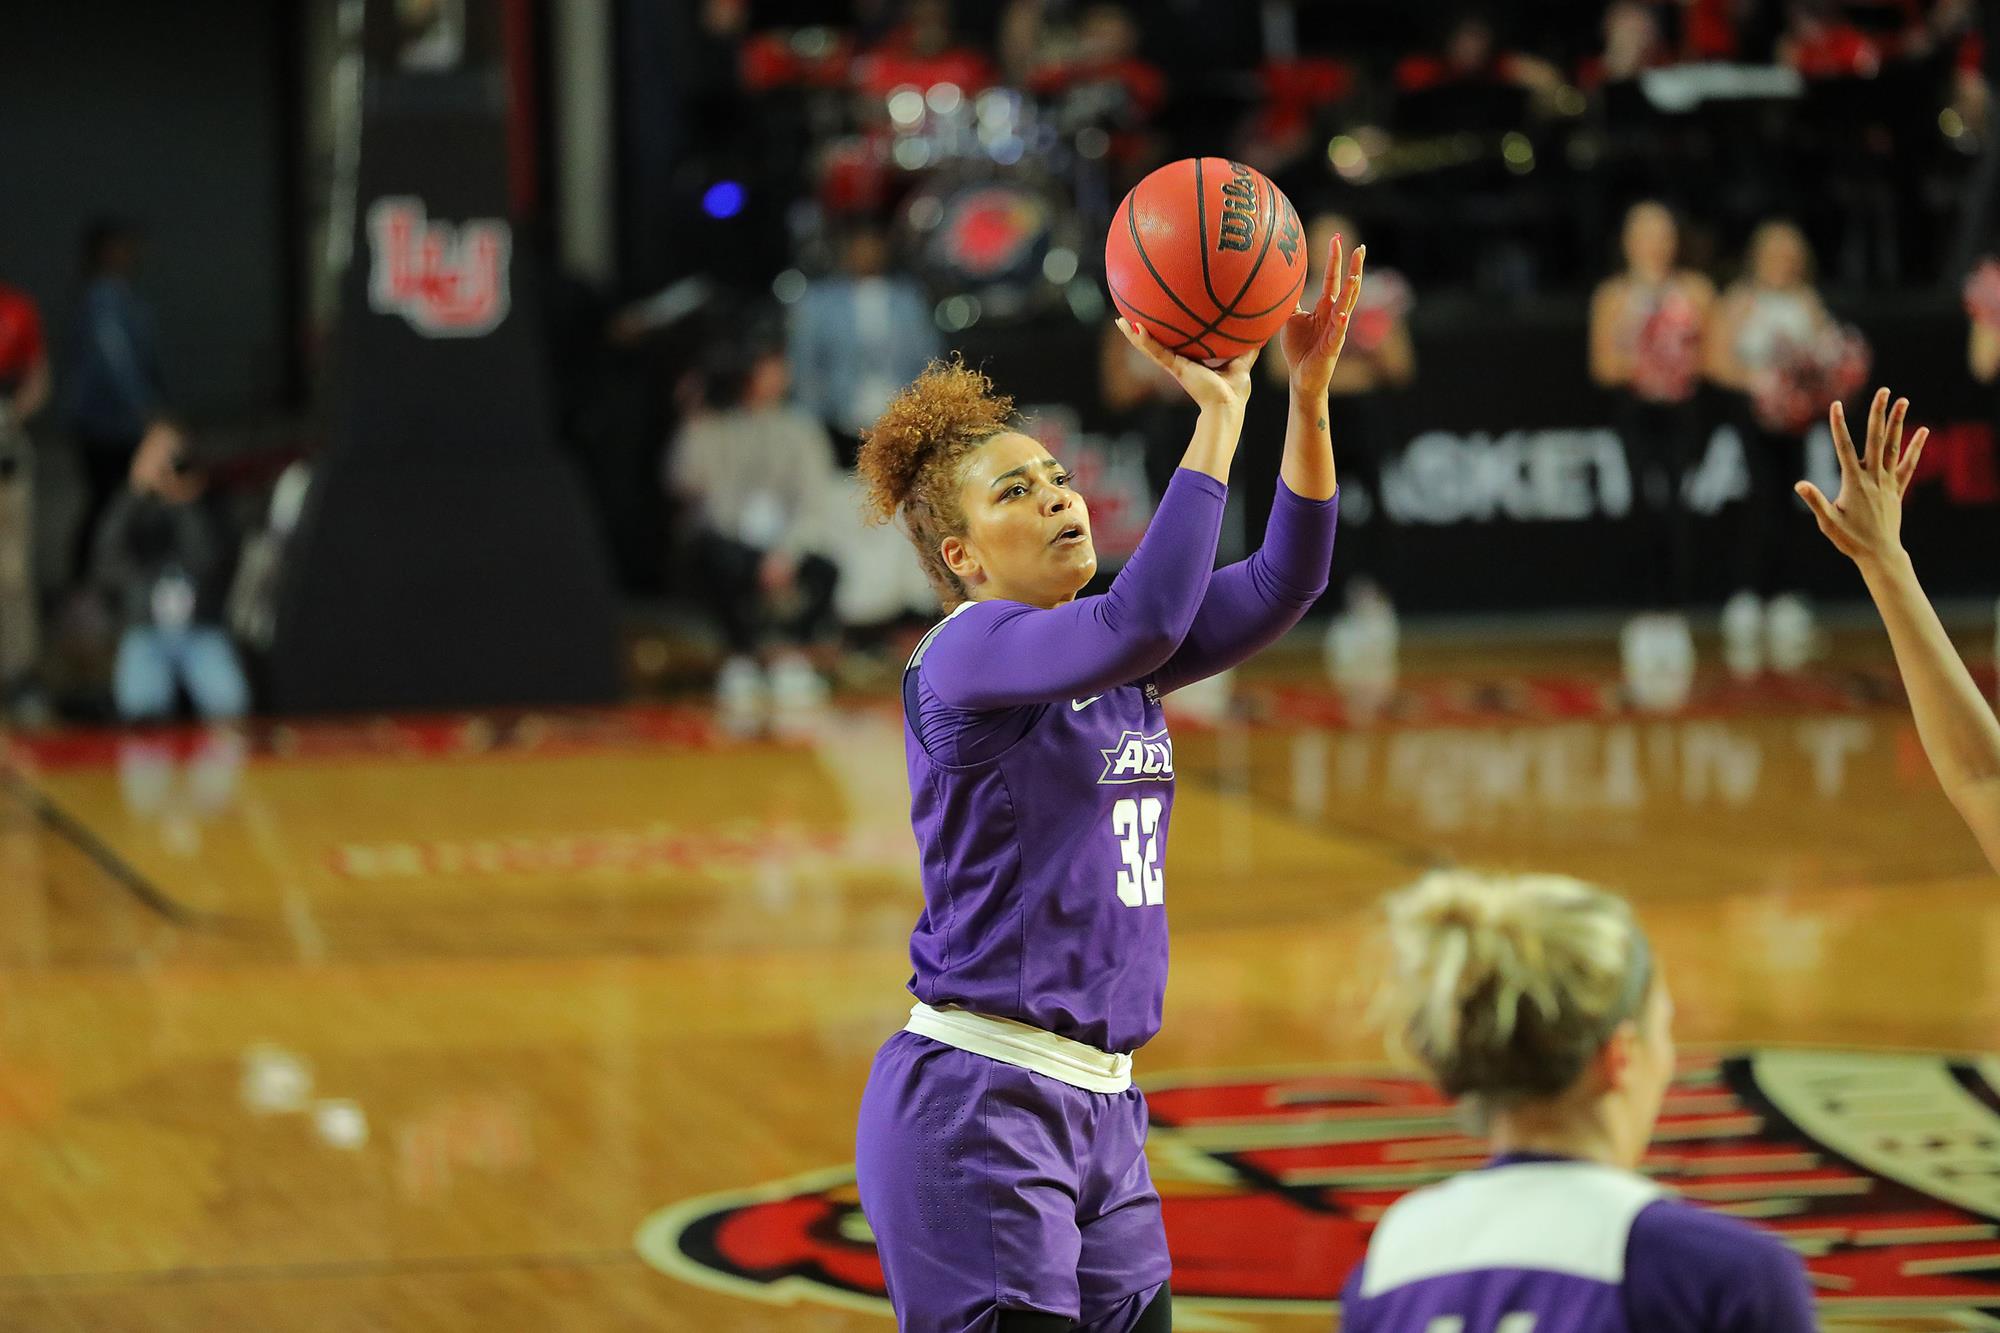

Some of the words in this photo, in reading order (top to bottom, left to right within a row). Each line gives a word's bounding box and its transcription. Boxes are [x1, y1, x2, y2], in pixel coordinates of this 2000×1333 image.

[1216, 160, 1257, 253] Wilso
[368, 197, 511, 336] LU
[1112, 738, 1173, 775] ACU
[1111, 797, 1164, 908] 32
